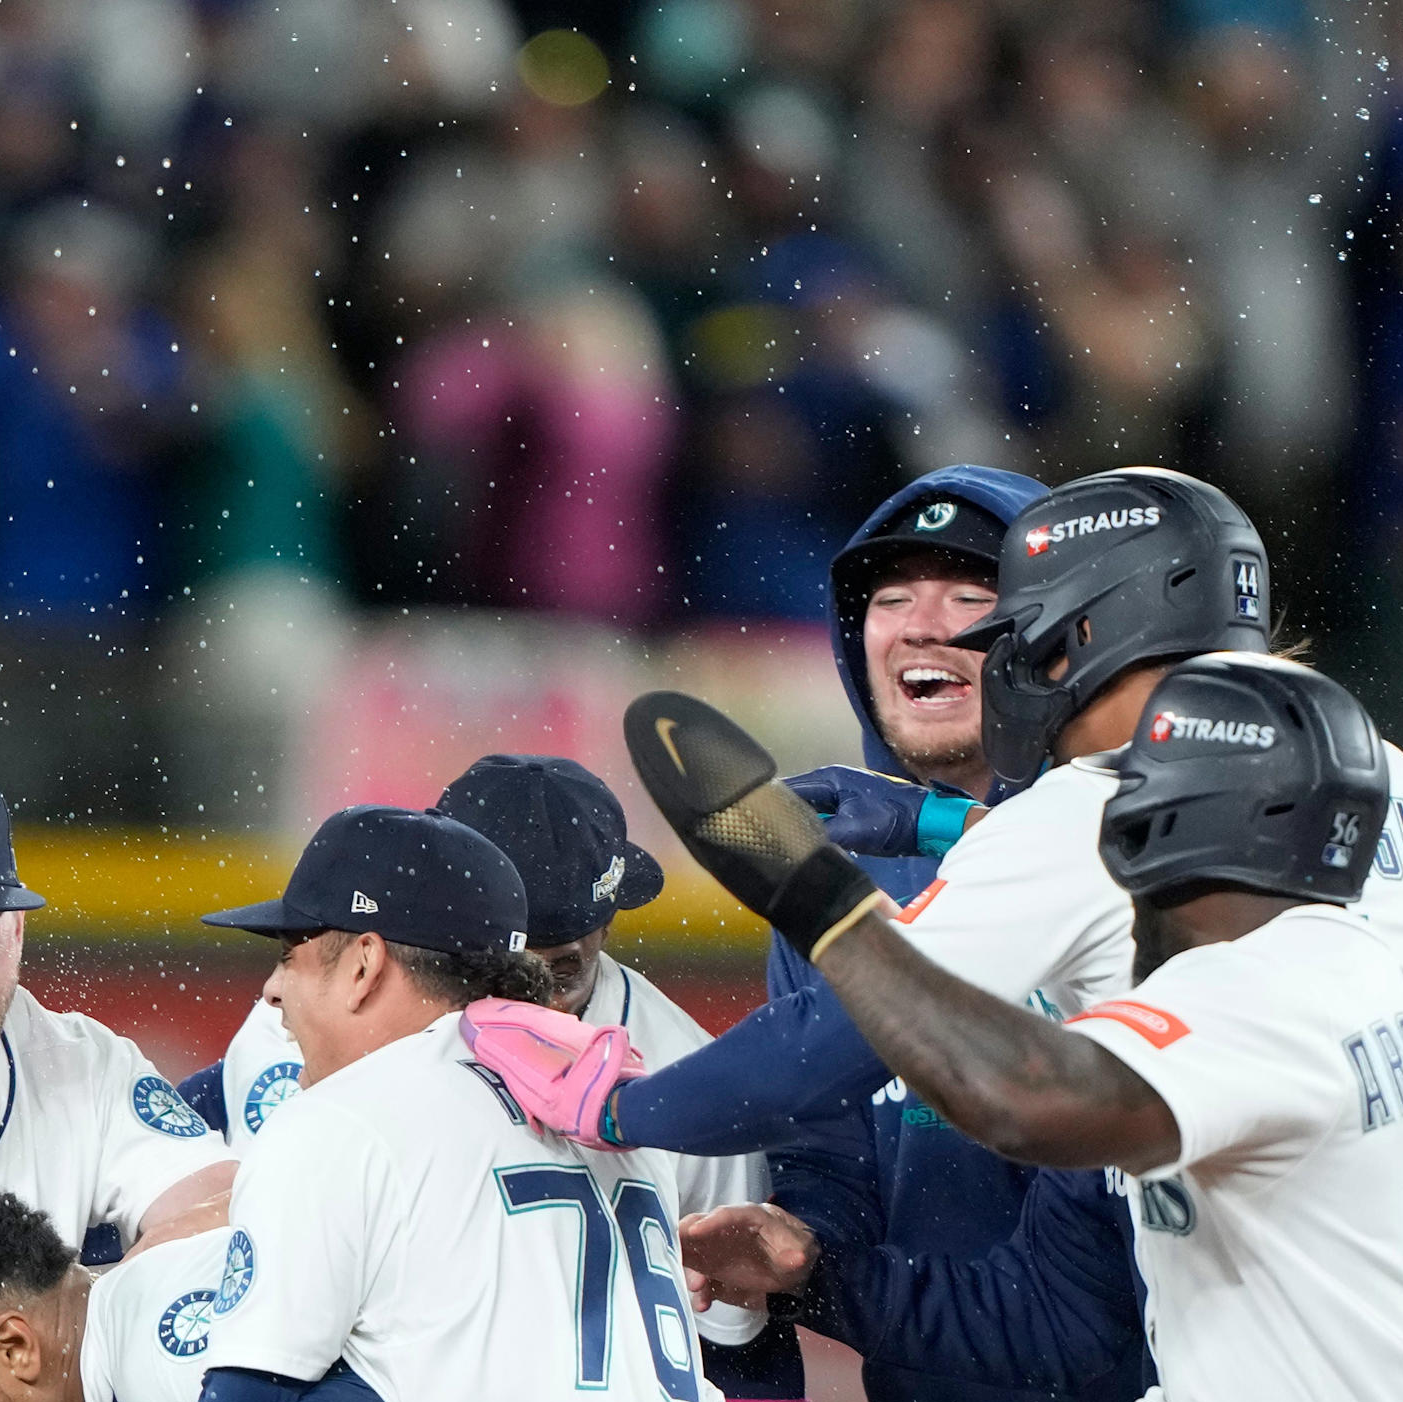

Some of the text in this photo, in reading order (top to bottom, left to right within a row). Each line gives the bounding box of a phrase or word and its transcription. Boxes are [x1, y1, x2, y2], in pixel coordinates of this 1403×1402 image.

[1051, 507, 1160, 542] STRAUSS
[1237, 564, 1258, 595] 44
[1171, 715, 1276, 749] STRAUSS
[1332, 812, 1359, 845] 56
[161, 1292, 211, 1348] SEATTLE
